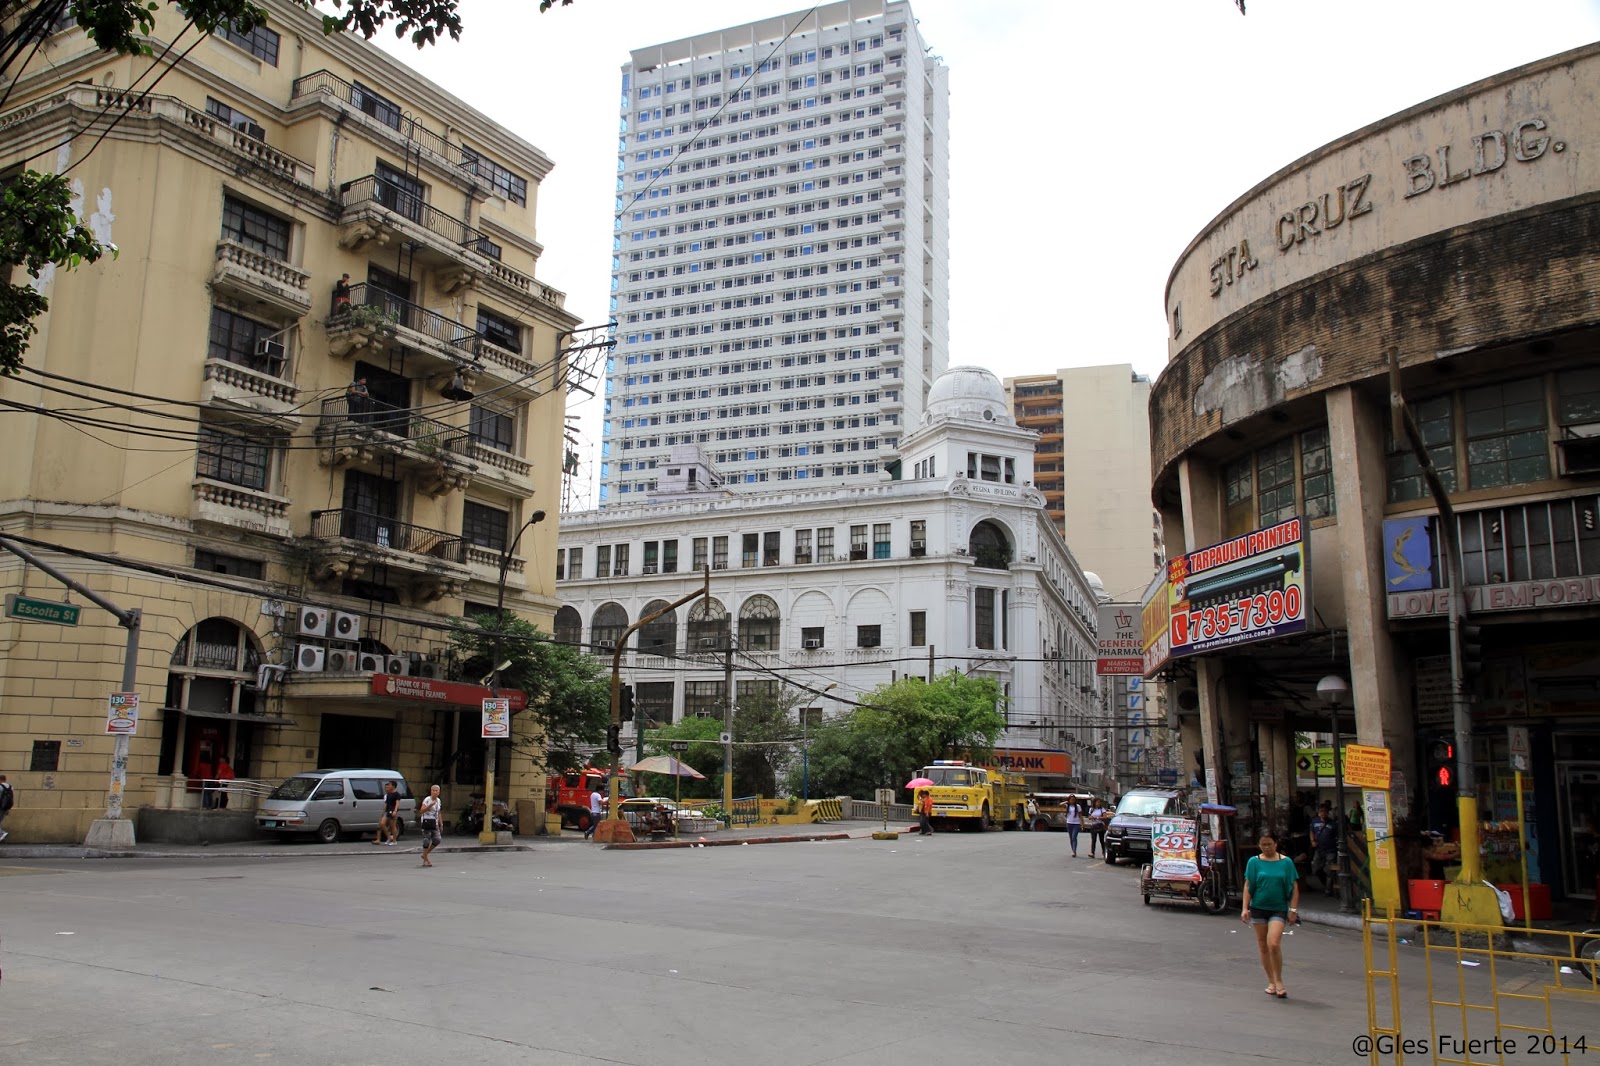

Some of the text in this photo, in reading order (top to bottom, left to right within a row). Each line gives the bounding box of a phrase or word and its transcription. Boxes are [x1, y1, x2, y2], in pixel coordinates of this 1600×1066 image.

[1274, 173, 1373, 252] CRUZ
[1402, 118, 1567, 200] BLDG.
[972, 485, 991, 494] REGINA
[1189, 519, 1300, 574] TARPAULIN PRINTER
[1172, 558, 1183, 570] WE
[1170, 567, 1186, 581] SELL
[1392, 589, 1476, 616] LOVEY
[17, 602, 75, 621] Escolta St
[1189, 584, 1301, 642] 735-7390
[1115, 631, 1134, 640] THE
[1192, 627, 1276, 650] www.premiumgraphics.com.ph
[396, 679, 431, 690] BANK OF THE
[395, 687, 447, 699] PHILIPPINE ISLANDS
[112, 696, 126, 704] 130
[485, 702, 497, 710] 130
[1153, 823, 1174, 834] 10
[1158, 835, 1194, 849] 295
